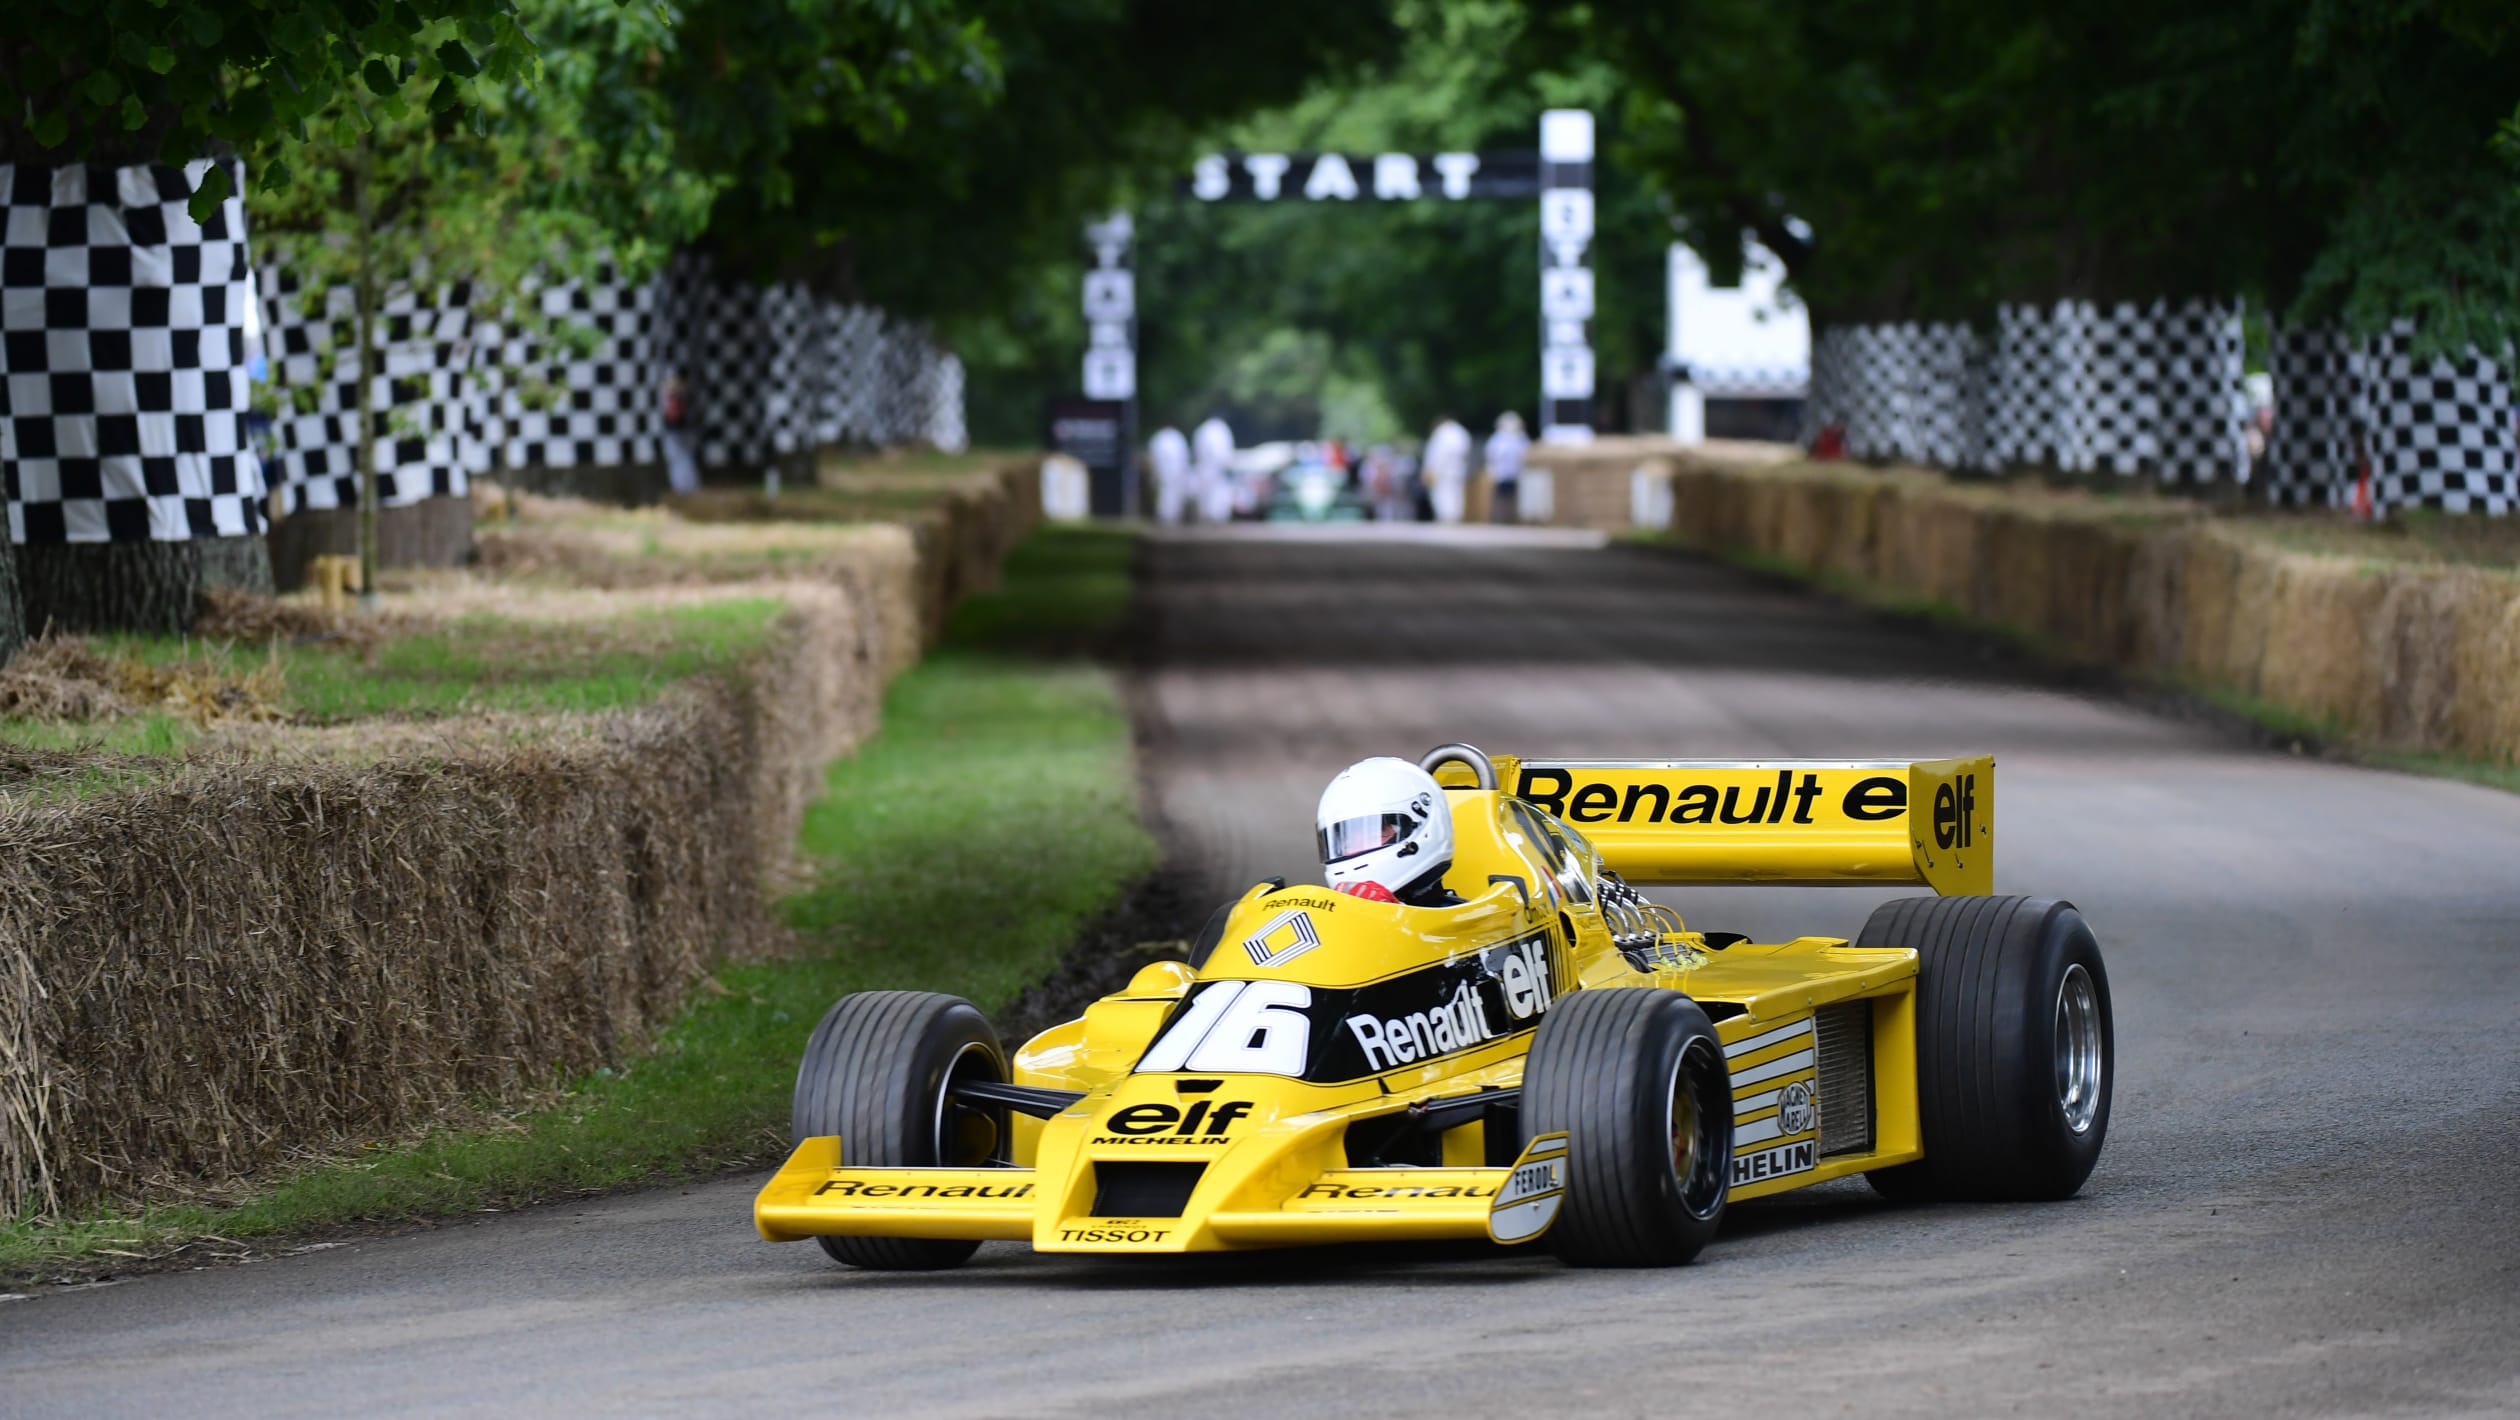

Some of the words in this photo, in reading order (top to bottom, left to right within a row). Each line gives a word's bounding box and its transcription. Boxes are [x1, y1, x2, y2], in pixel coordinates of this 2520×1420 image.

[1192, 152, 1481, 200] START
[1515, 769, 1823, 825] Renault
[1842, 776, 1908, 821] e
[1934, 774, 1975, 850] elf
[1262, 897, 1336, 912] Renault
[1346, 979, 1493, 1072] Renault
[1503, 939, 1552, 1019] elf
[1133, 979, 1312, 1077] 16
[1107, 1100, 1256, 1136] elf
[1090, 1137, 1231, 1145] MICHELIN
[1732, 1143, 1813, 1184] HELIN
[814, 1180, 1036, 1198] Renaul
[1297, 1183, 1497, 1199] Renau
[1060, 1230, 1171, 1242] TISSOT
